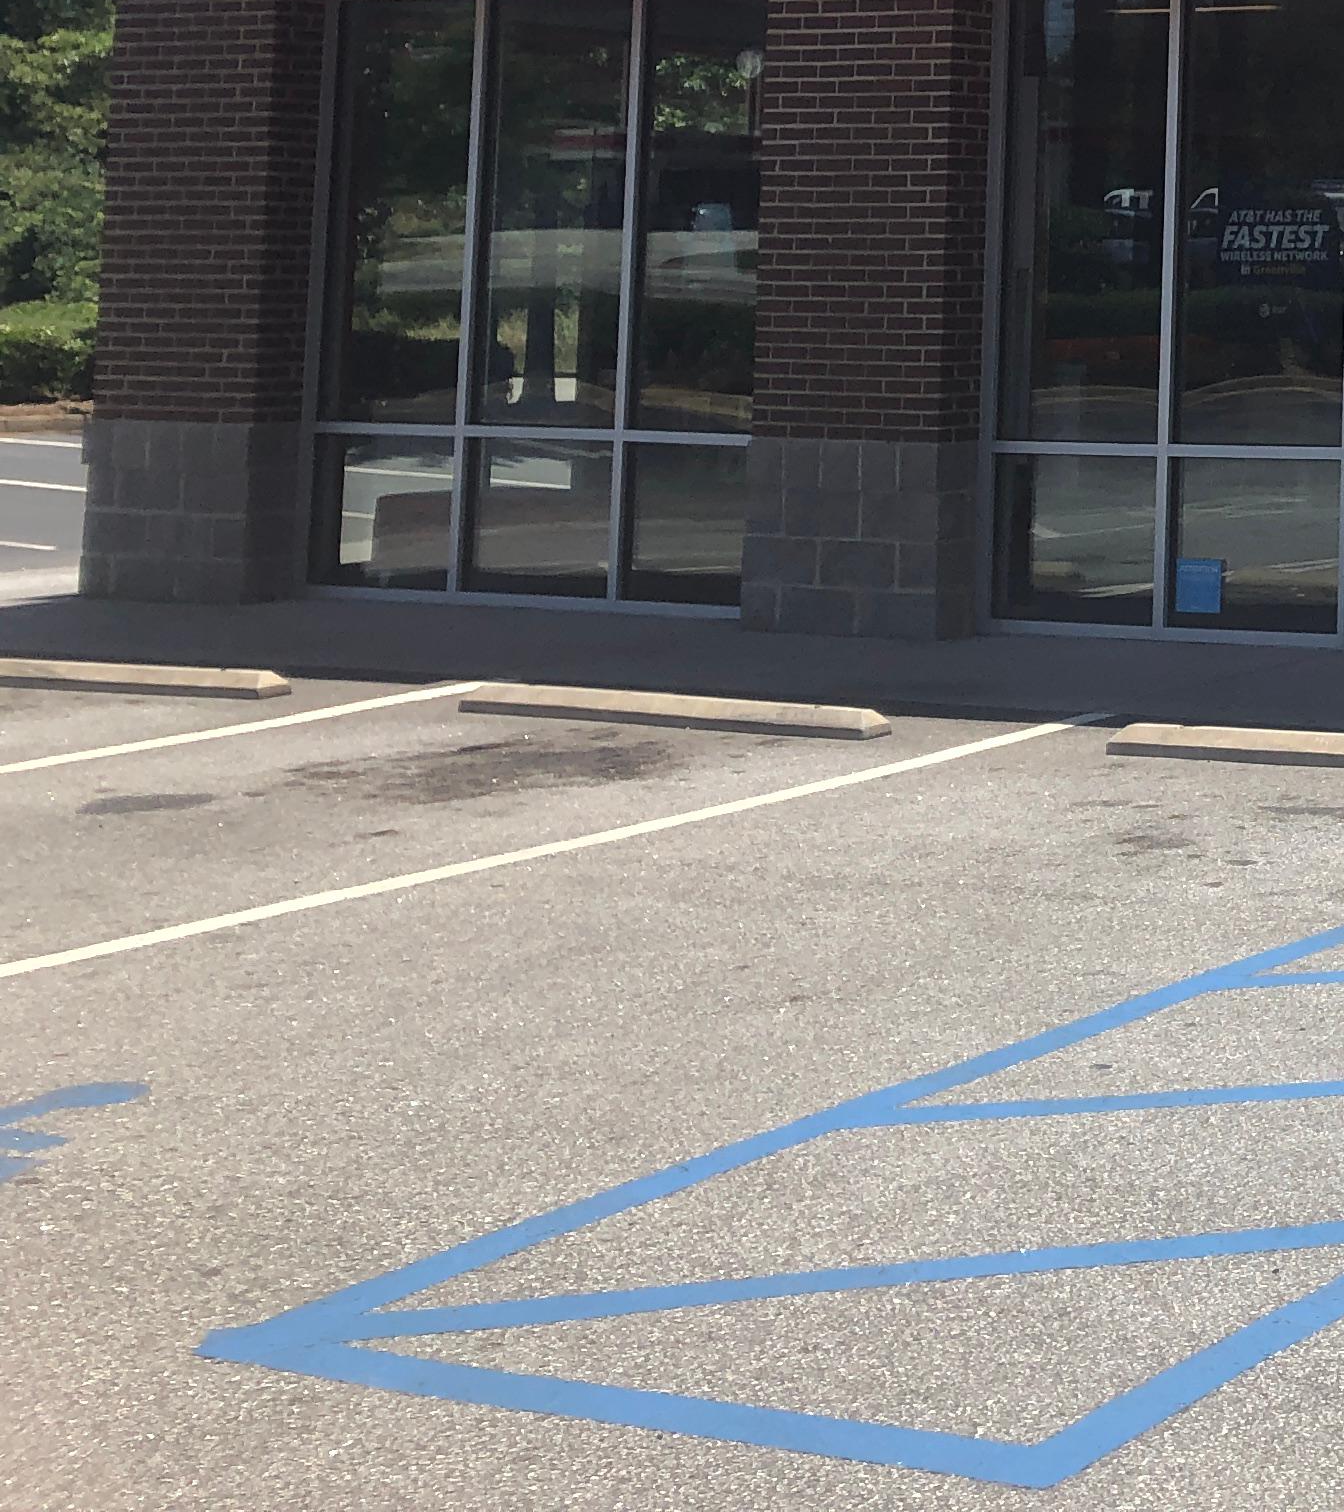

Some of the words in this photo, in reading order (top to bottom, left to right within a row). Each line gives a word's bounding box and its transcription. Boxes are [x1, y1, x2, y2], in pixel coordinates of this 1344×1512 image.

[1228, 209, 1264, 223] AT&T
[1265, 209, 1293, 223] HAS
[1295, 209, 1322, 222] THE
[1221, 224, 1330, 249] FASTEST
[1220, 250, 1271, 262] WIRELESS
[1273, 250, 1329, 262] NETWORK
